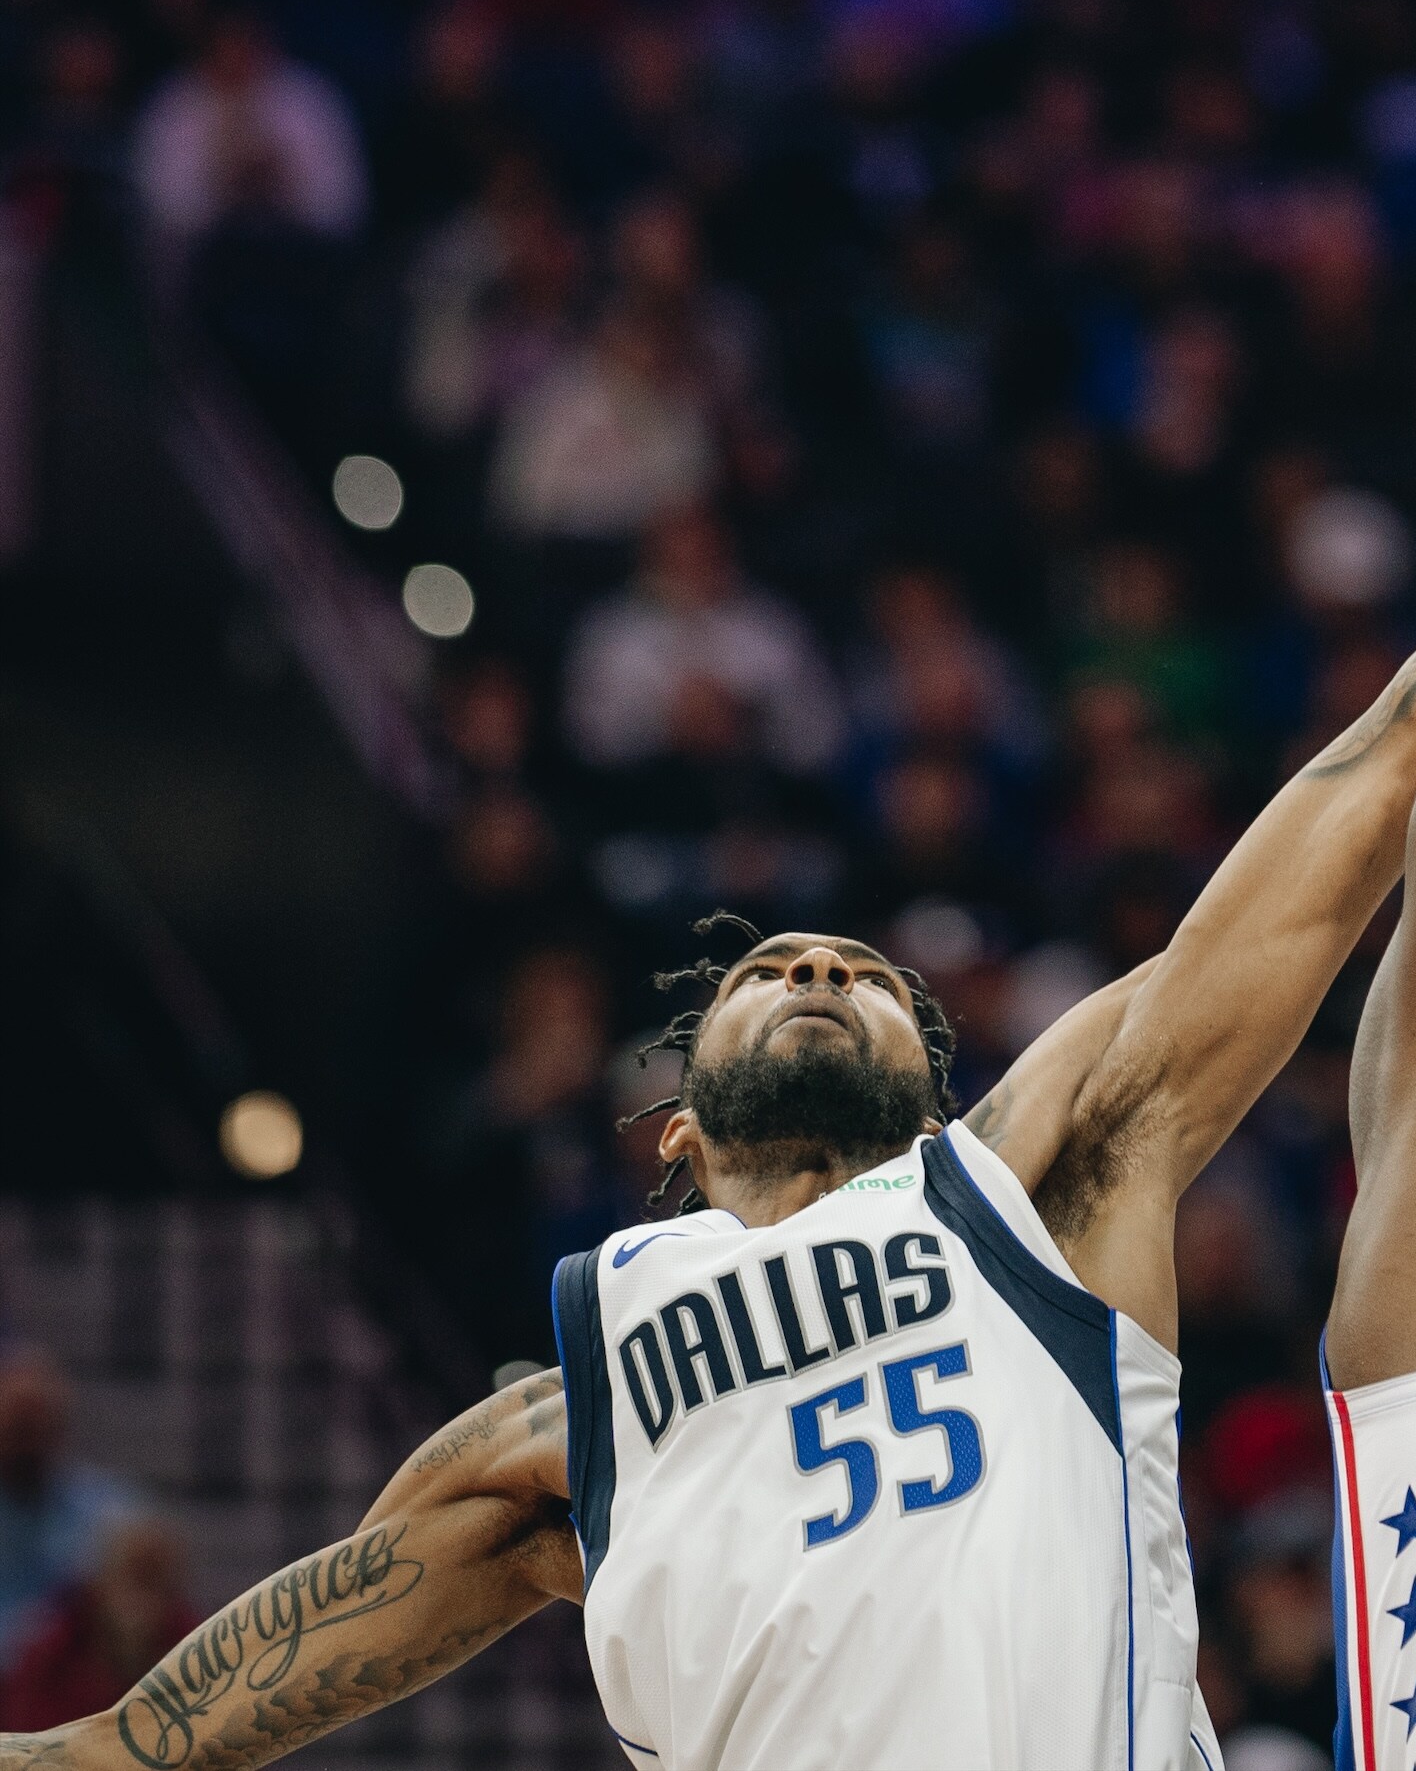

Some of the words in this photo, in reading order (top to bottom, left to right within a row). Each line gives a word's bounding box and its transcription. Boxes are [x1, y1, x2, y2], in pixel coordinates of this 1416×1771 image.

[838, 1174, 917, 1191] ime
[618, 1231, 954, 1453] DALLAS
[786, 1339, 986, 1552] 55
